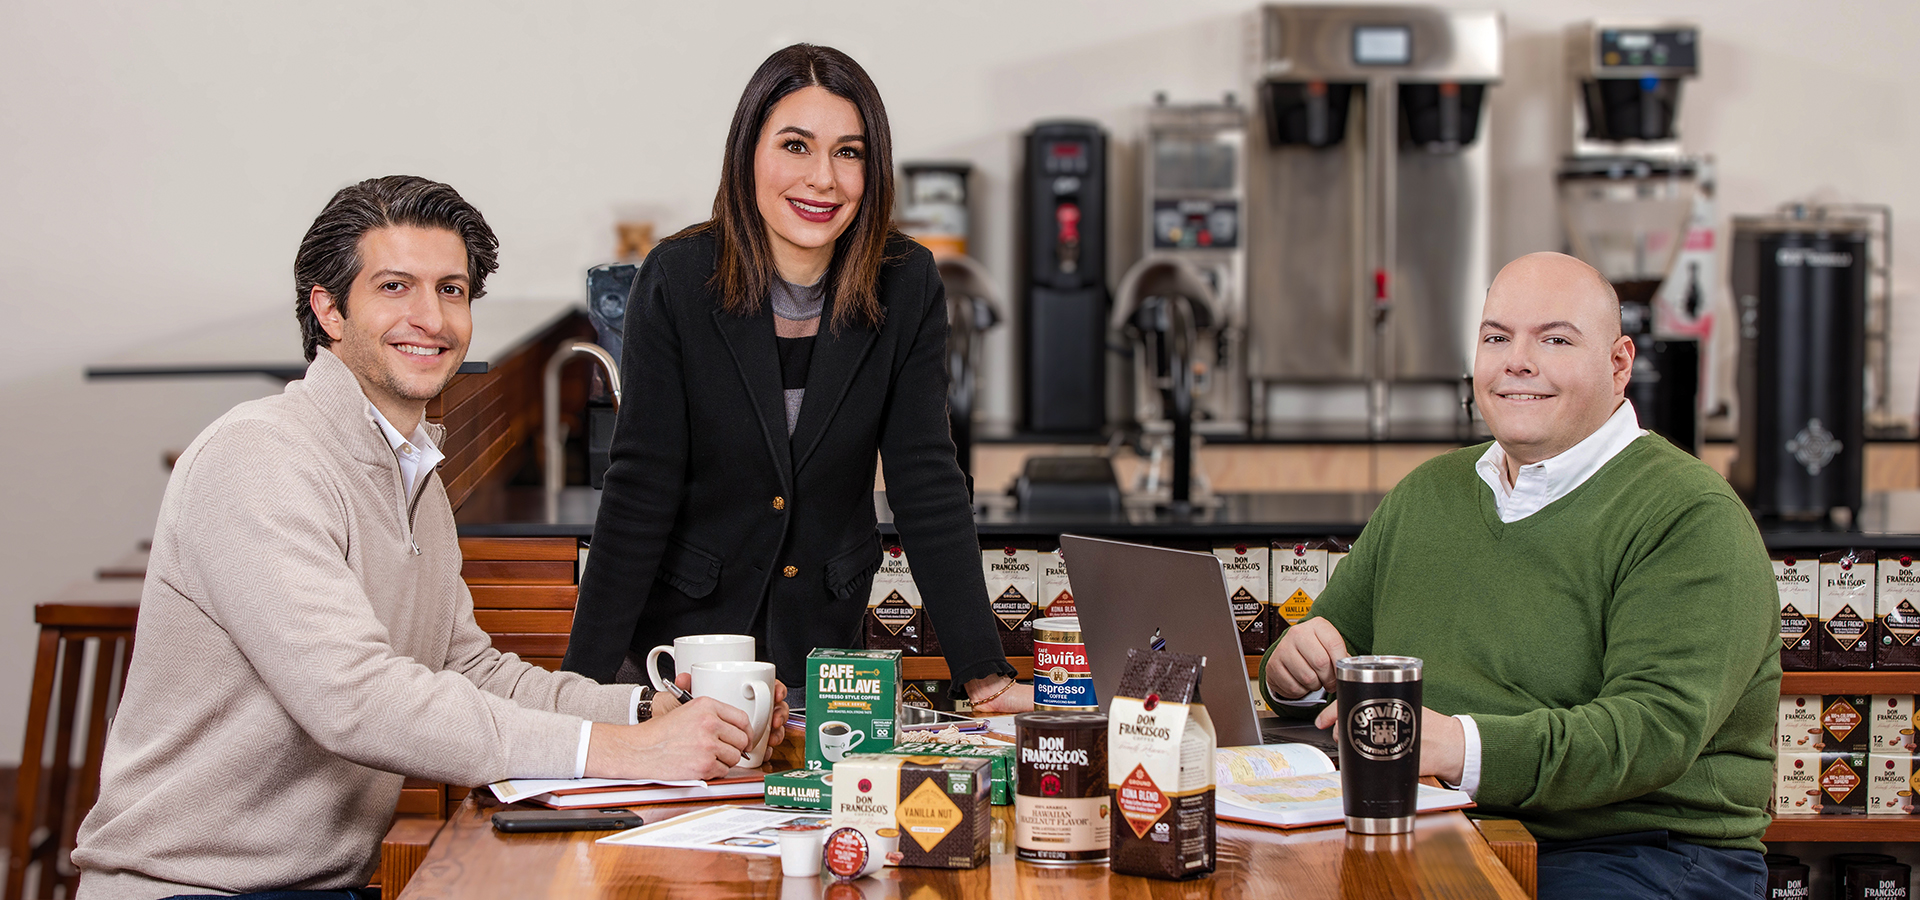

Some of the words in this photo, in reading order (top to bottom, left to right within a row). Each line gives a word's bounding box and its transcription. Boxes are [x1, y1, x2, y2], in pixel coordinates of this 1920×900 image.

[1234, 556, 1249, 564] DON
[1293, 558, 1307, 566] DON
[991, 563, 1030, 572] FRANCISCO'S
[1223, 562, 1260, 571] FRANCISCO'S
[1280, 564, 1319, 573] FRANCISCO'S
[1775, 574, 1810, 583] RANCISCO'S
[1886, 575, 1920, 584] FRANCISCO
[993, 602, 1017, 610] BREAKFAST
[1017, 602, 1031, 610] BLEND
[1232, 602, 1244, 610] NCH
[1244, 602, 1259, 610] ROAST
[876, 607, 900, 615] BREAKFAST
[900, 607, 914, 615] BLEND
[1790, 619, 1808, 627] FRENCH
[1830, 620, 1847, 628] DOUBLE
[1847, 620, 1865, 628] FRENCH
[1907, 615, 1920, 624] ROAS
[819, 663, 855, 679] CAFE
[819, 678, 837, 693] LA
[839, 678, 881, 694] LLAVE
[1038, 683, 1086, 695] espresso
[1137, 714, 1157, 726] DON
[1354, 703, 1412, 729] gaviña
[1118, 722, 1171, 741] FRANCISCO'S
[1781, 734, 1791, 743] 12
[1873, 735, 1883, 743] 12
[1038, 736, 1065, 751] DON
[1354, 738, 1388, 755] gourmet
[1389, 737, 1411, 754] coffee
[1021, 747, 1089, 766] FRANCISCO'S
[807, 759, 822, 770] 12
[1033, 762, 1070, 771] COFFEE
[1128, 778, 1152, 787] GROUND
[1874, 775, 1905, 783] FRANCISCO'S
[767, 785, 786, 797] CAFE
[786, 786, 797, 797] LA
[797, 787, 821, 798] LLAVE
[1122, 787, 1138, 799] KONA
[1138, 789, 1159, 802] BLEND
[855, 795, 873, 804] DON
[1779, 796, 1789, 804] 12
[1870, 796, 1880, 804] 12
[840, 803, 888, 815] FRANCISCO'S
[903, 807, 935, 818] VANILLA
[937, 809, 953, 819] NUT
[1032, 810, 1072, 818] HAWAIIAN
[1021, 815, 1056, 826] HAZELNUT
[1787, 879, 1802, 889] DON
[1879, 880, 1896, 889] DON
[1772, 886, 1809, 899] FRANCISCO'S
[1864, 886, 1906, 898] FRANCISCO'S
